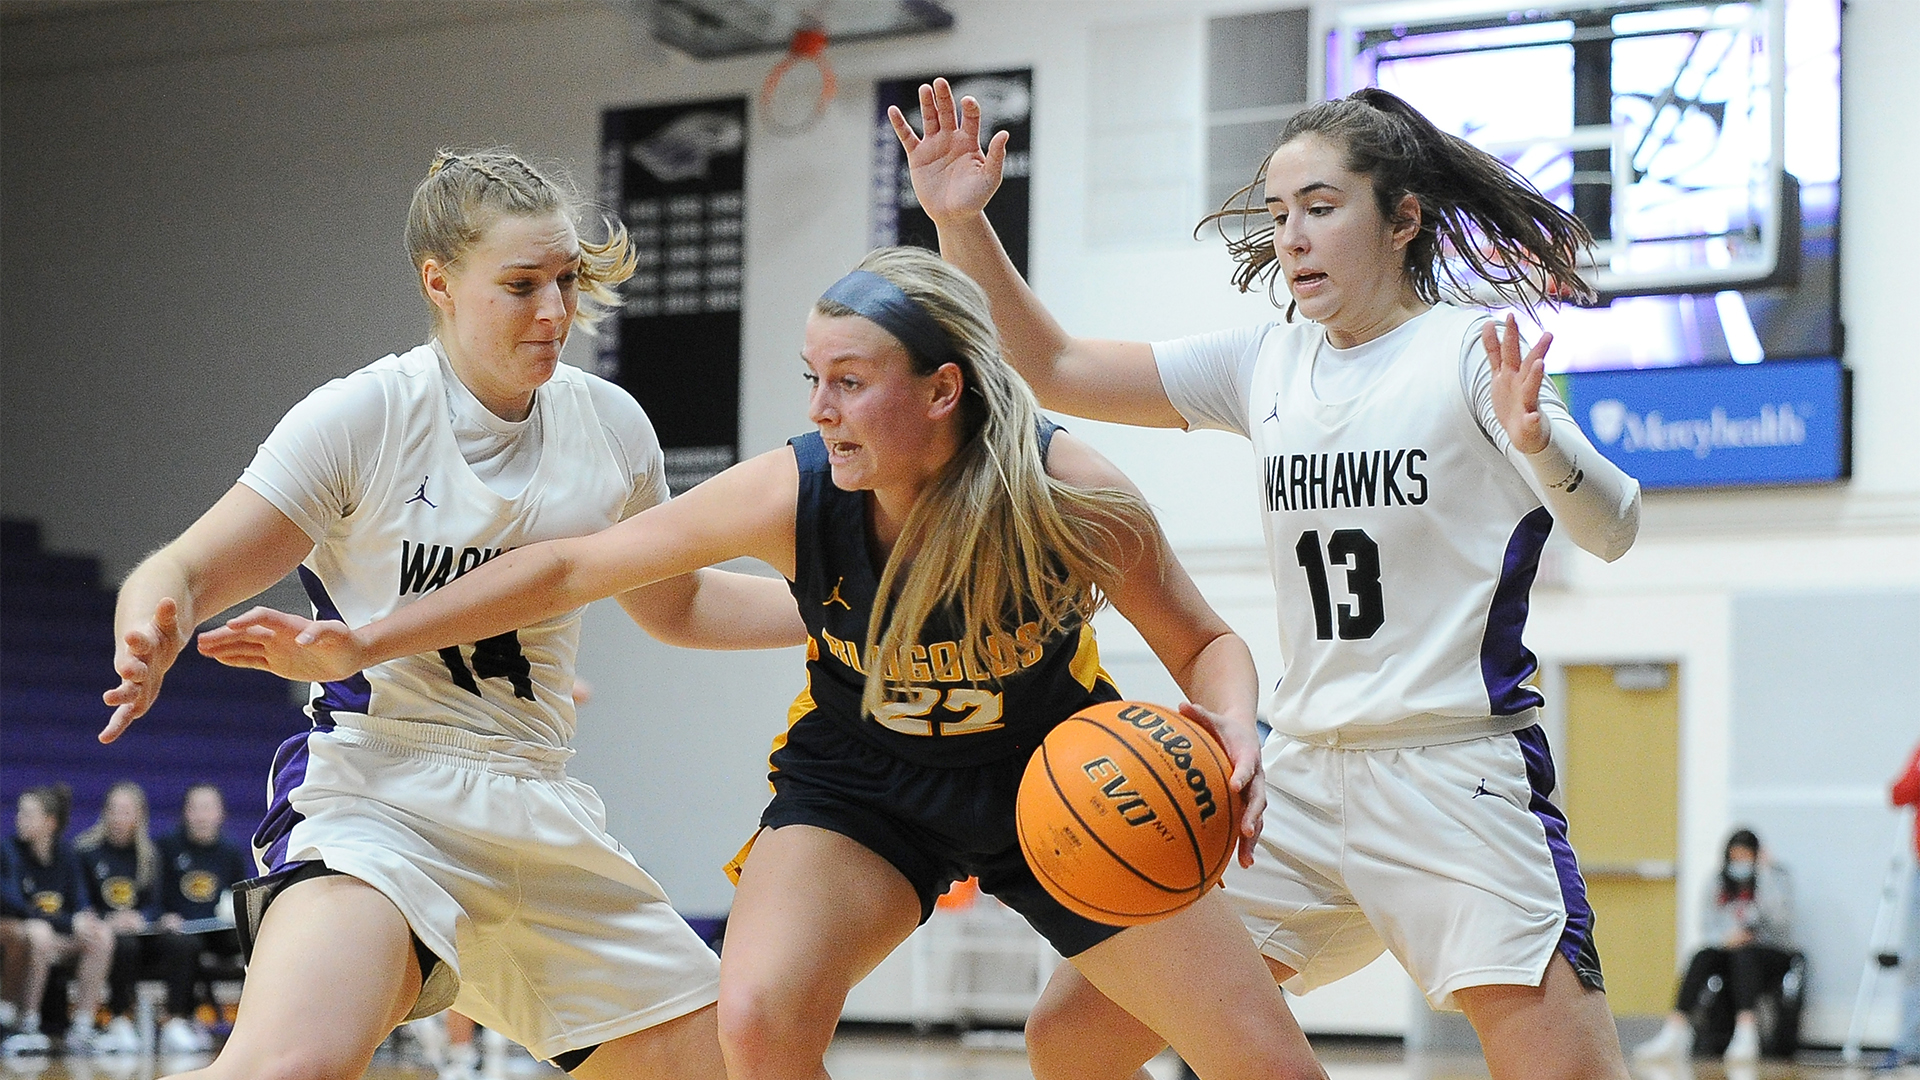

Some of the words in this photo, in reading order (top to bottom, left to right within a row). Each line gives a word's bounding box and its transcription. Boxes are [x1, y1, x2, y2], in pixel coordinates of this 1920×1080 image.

[1264, 448, 1428, 513] WARHAWKS
[1295, 528, 1385, 640] 13
[871, 686, 1005, 737] 22
[1081, 755, 1158, 828] EVO
[1152, 820, 1177, 842] NXT
[1117, 704, 1218, 823] Wilson
